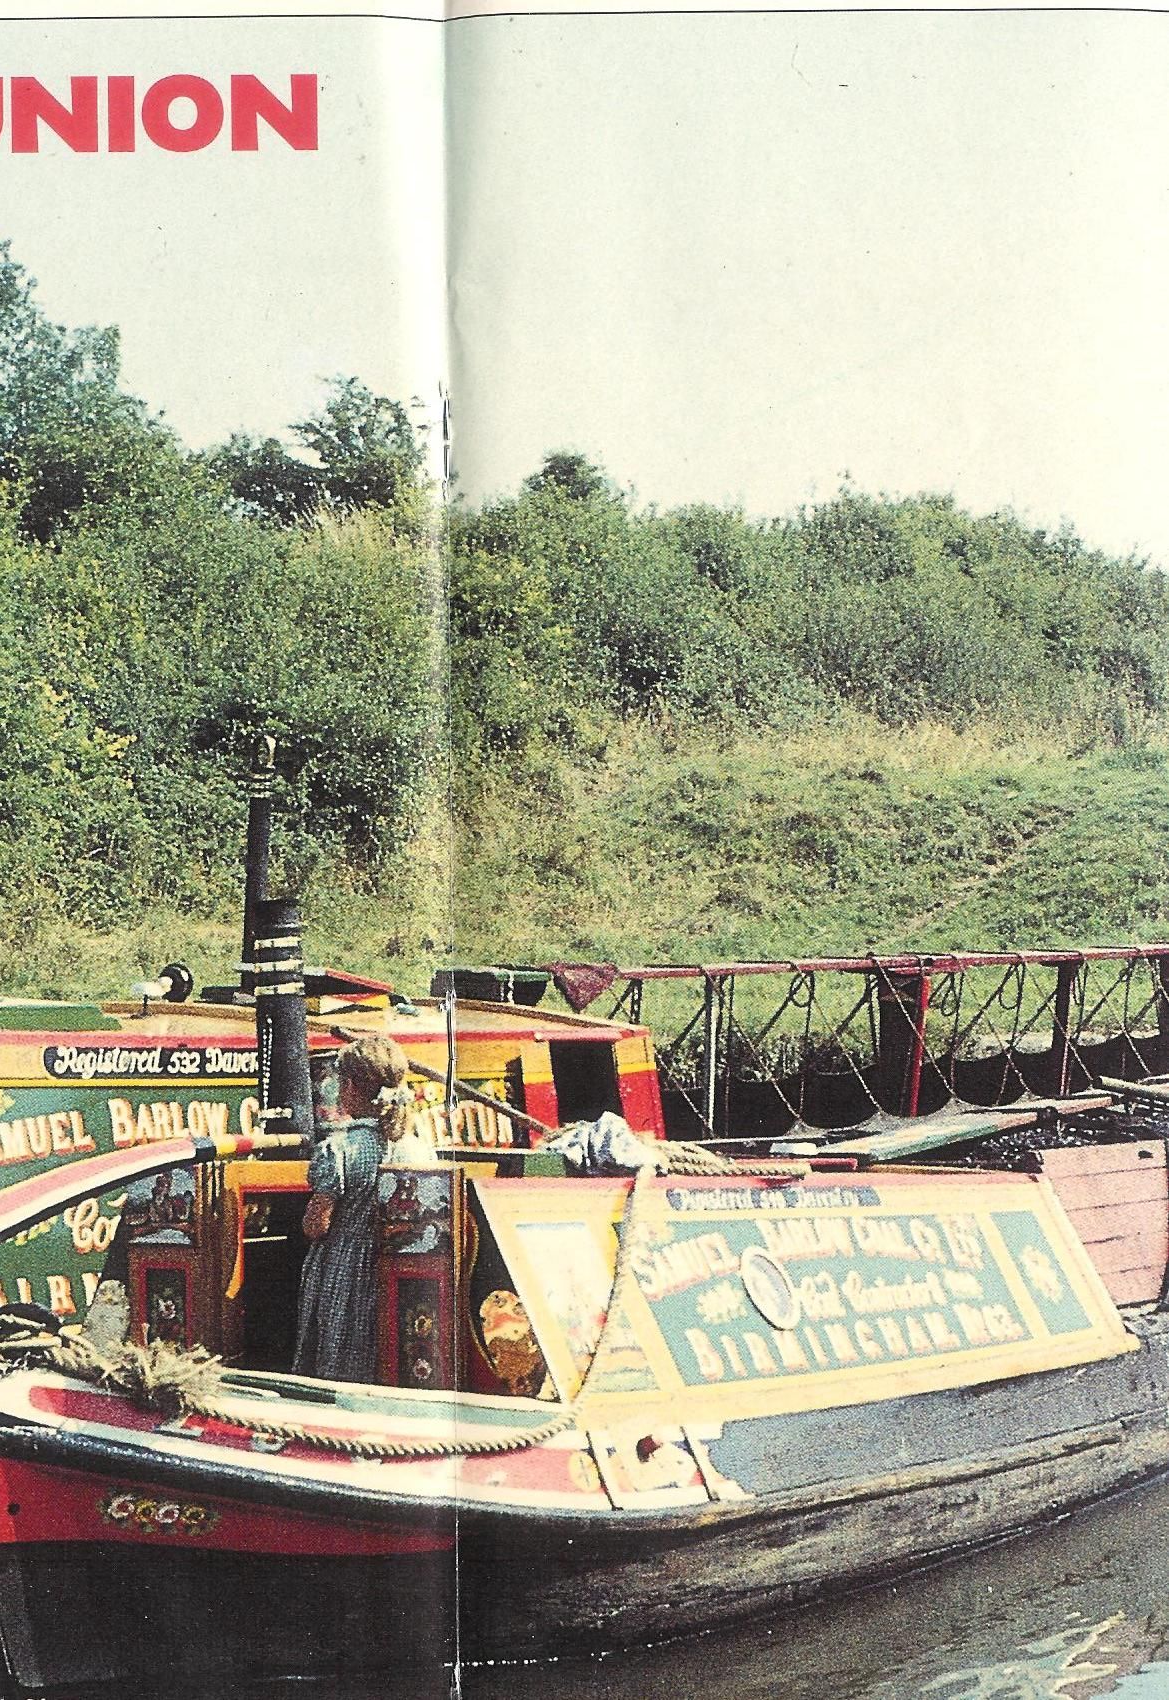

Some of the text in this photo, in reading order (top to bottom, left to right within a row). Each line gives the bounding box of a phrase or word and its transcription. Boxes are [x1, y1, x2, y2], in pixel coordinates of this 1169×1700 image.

[54, 1047, 163, 1079] Registered
[167, 1051, 200, 1074] 532
[107, 1097, 229, 1147] BARLOW
